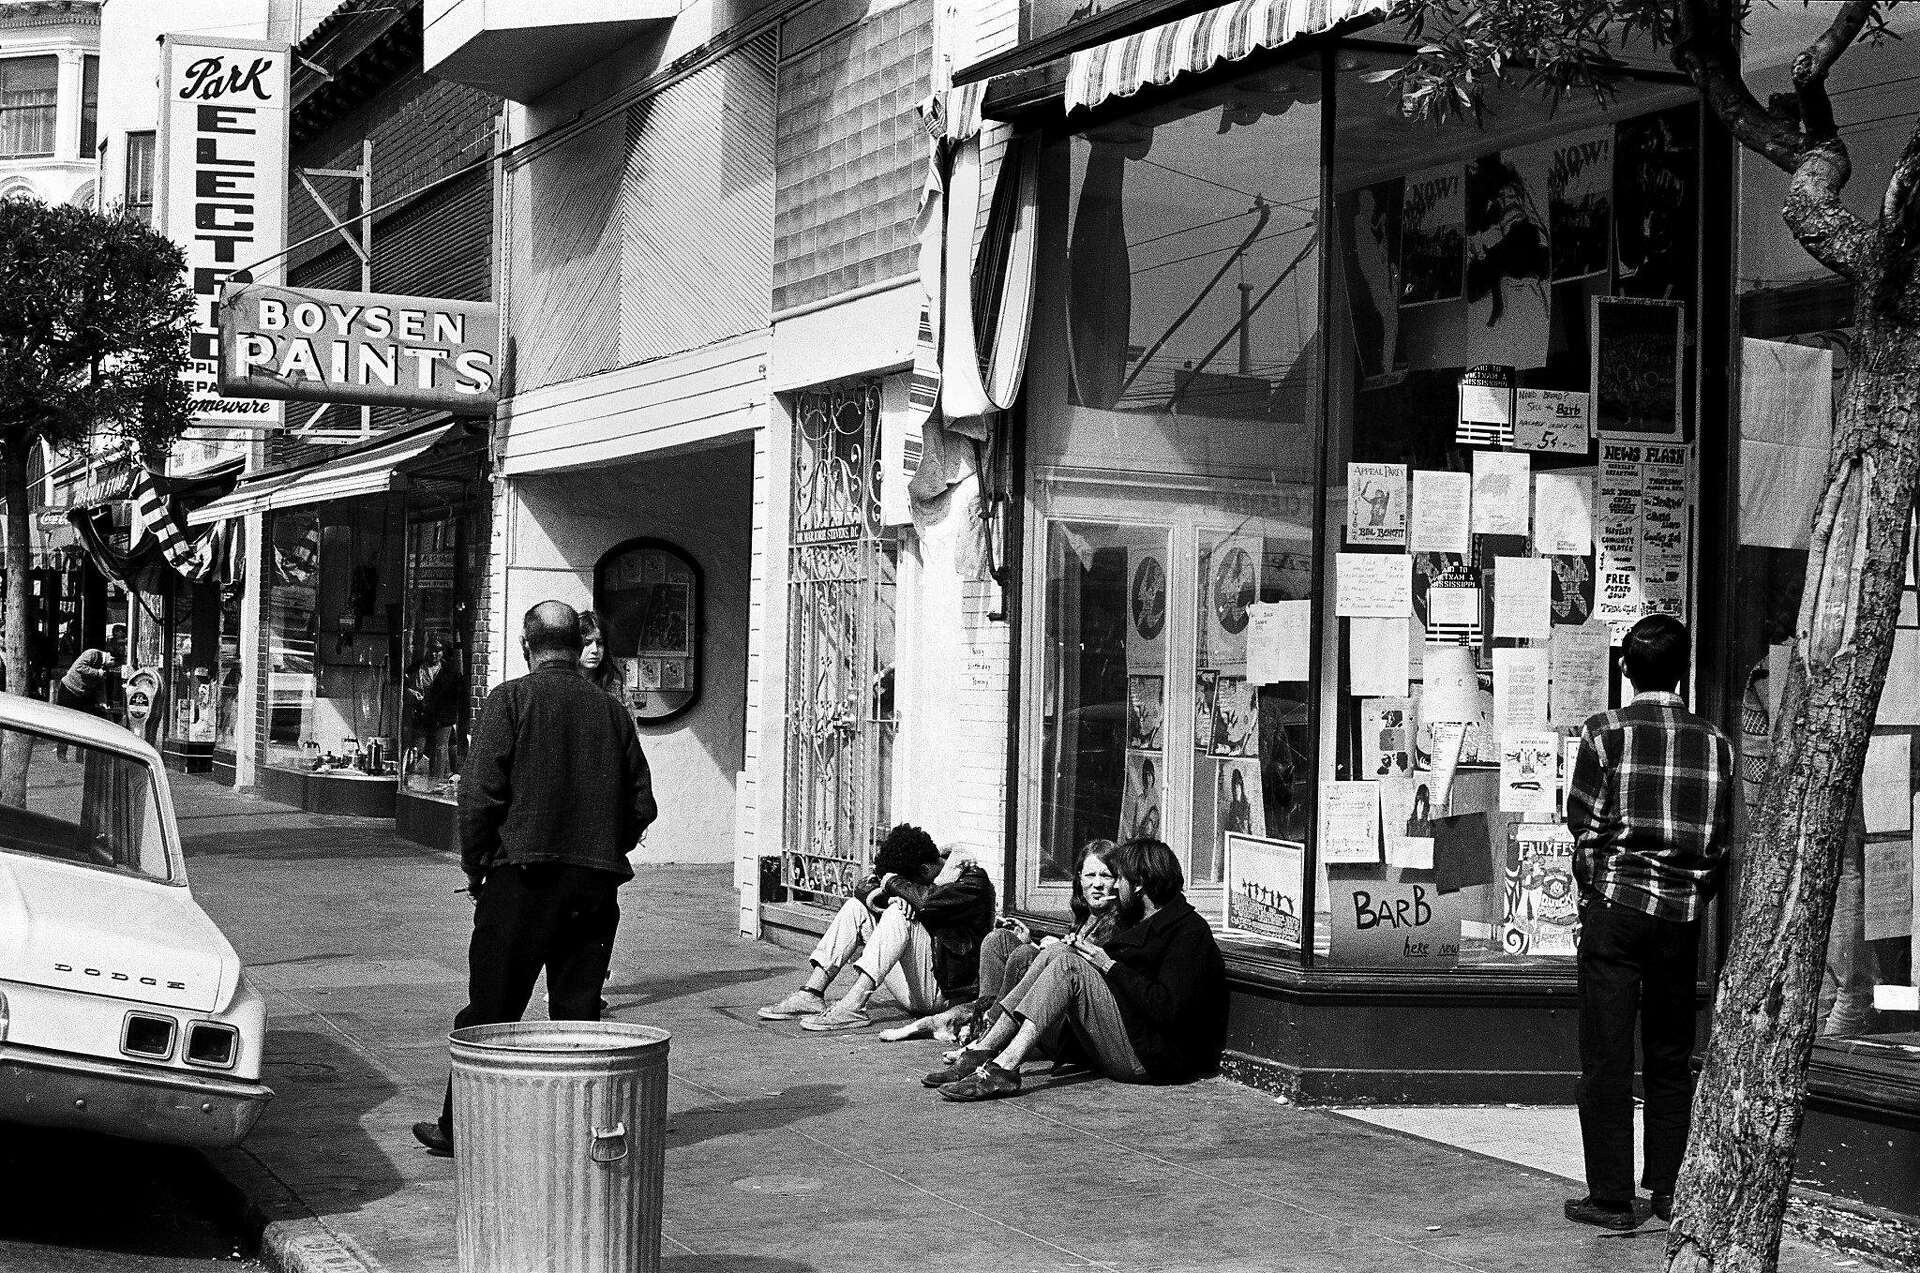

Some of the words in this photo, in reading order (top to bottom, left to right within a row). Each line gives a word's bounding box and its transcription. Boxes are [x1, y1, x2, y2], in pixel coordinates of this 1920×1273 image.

[178, 55, 273, 101] Park
[258, 298, 467, 345] BOYSEN
[234, 331, 495, 396] PAINTS
[1603, 445, 1641, 461] NEWS
[1645, 447, 1685, 464] FLASH
[1606, 573, 1630, 584] FREE
[1352, 885, 1431, 930] BARB
[55, 963, 185, 989] DODGE
